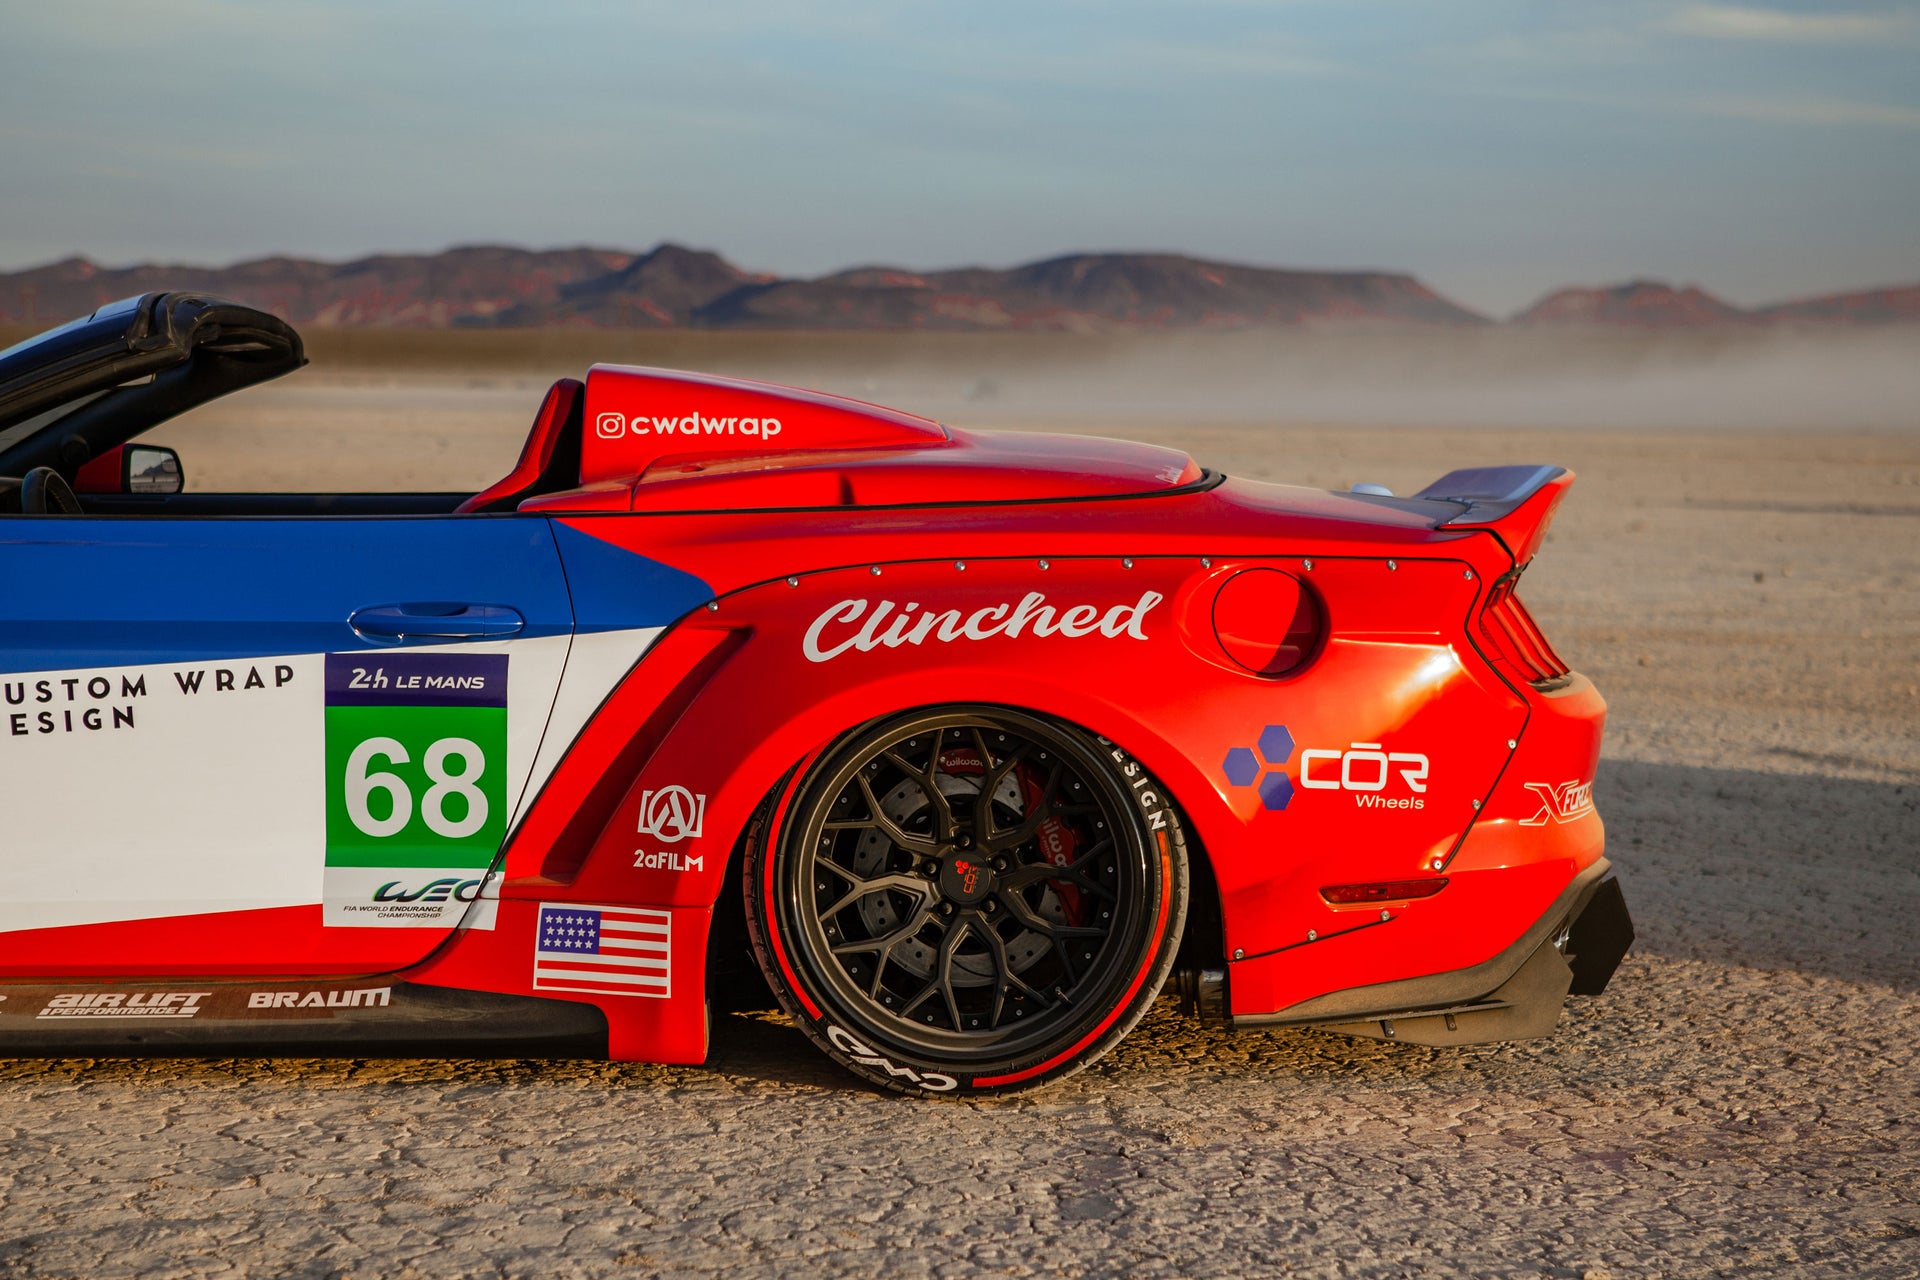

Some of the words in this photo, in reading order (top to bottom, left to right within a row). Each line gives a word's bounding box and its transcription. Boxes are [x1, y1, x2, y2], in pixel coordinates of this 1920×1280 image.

[631, 412, 782, 440] cwdwrap
[802, 591, 1163, 663] Clinched
[4, 673, 147, 705] USTOM
[174, 665, 295, 695] WRAP
[395, 676, 422, 689] LE
[424, 676, 485, 689] MANS
[9, 706, 135, 736] ESIGN
[344, 736, 489, 838] 68
[1355, 794, 1425, 810] Wheels
[632, 848, 704, 872] 2aFILM
[372, 878, 483, 902] WEC
[389, 905, 444, 913] ENDURANCE
[126, 993, 213, 1007] LIFT
[247, 988, 391, 1009] BRAUM
